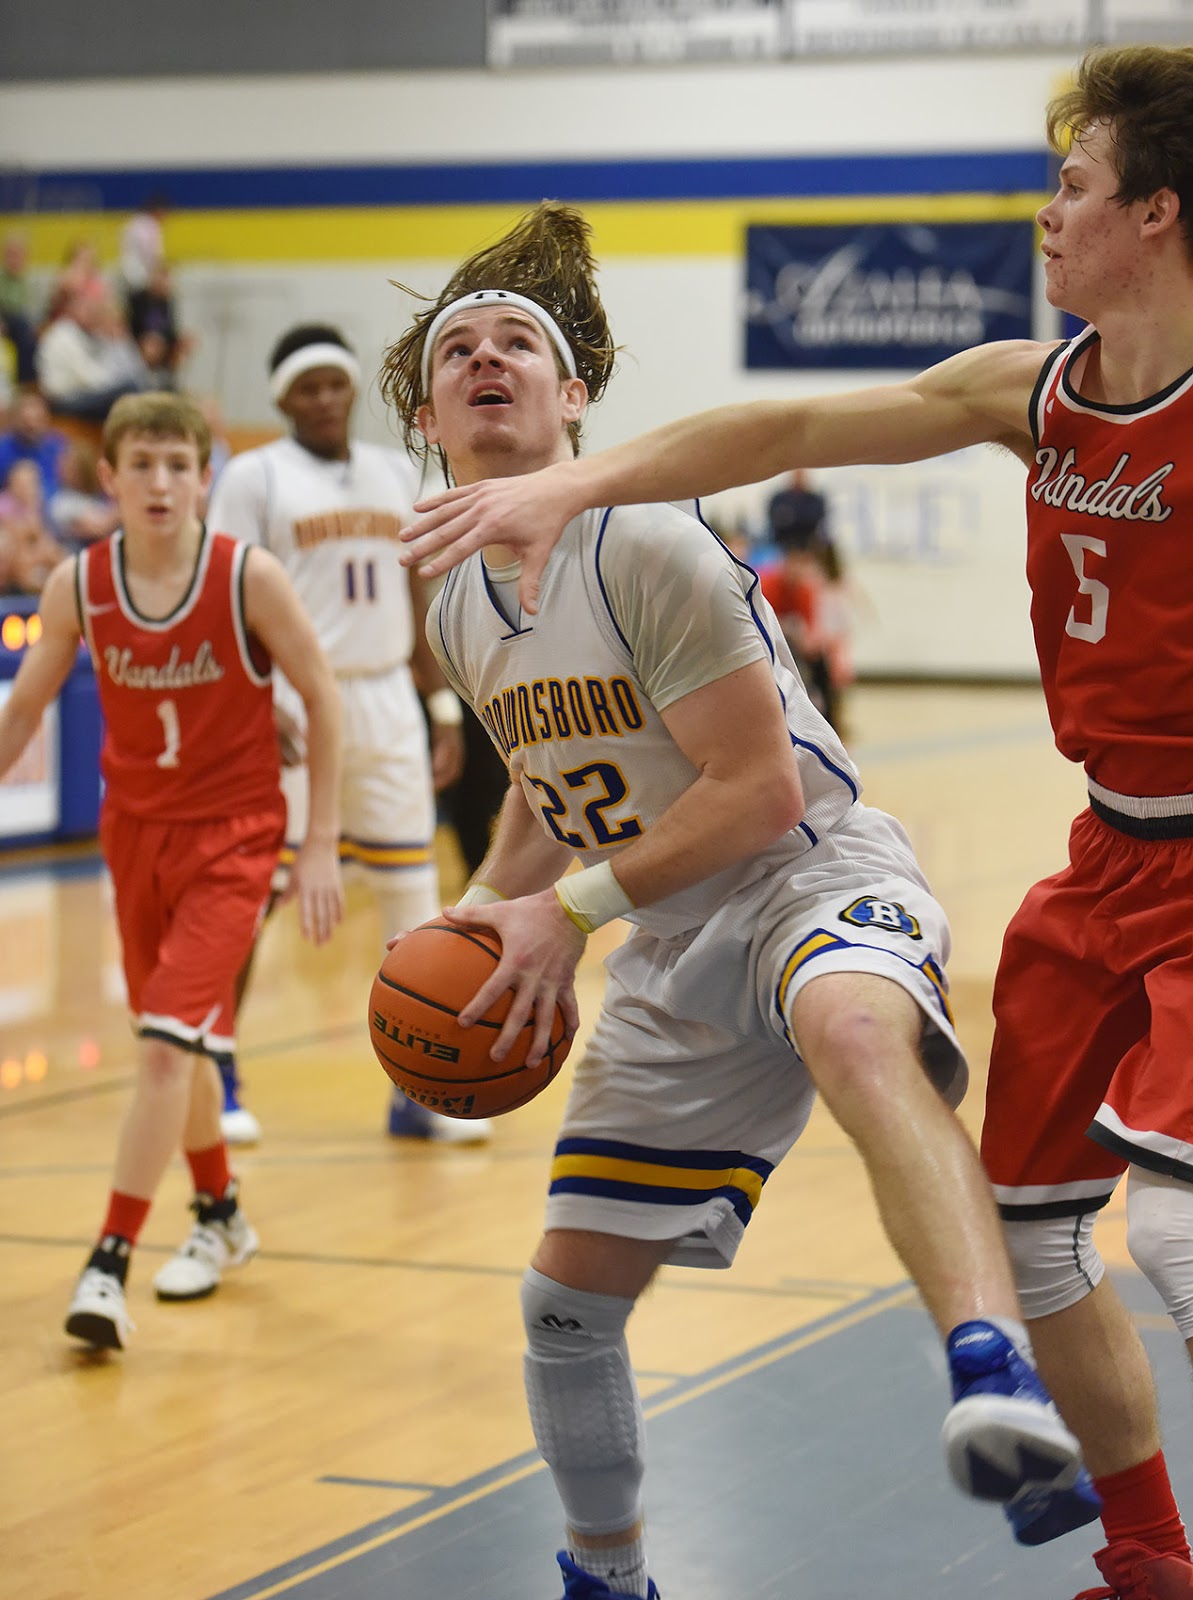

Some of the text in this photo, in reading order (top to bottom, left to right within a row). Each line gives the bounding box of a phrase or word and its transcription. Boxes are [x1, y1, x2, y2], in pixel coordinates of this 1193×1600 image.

[1030, 446, 1175, 522] Vandals
[342, 557, 378, 603] 11
[1060, 533, 1110, 644] 5
[103, 640, 225, 690] Vandals
[156, 698, 181, 769] 1
[479, 675, 647, 759] ROWNSBORO
[522, 759, 646, 849] 22
[865, 900, 902, 927] B
[373, 1010, 461, 1063] ELITE
